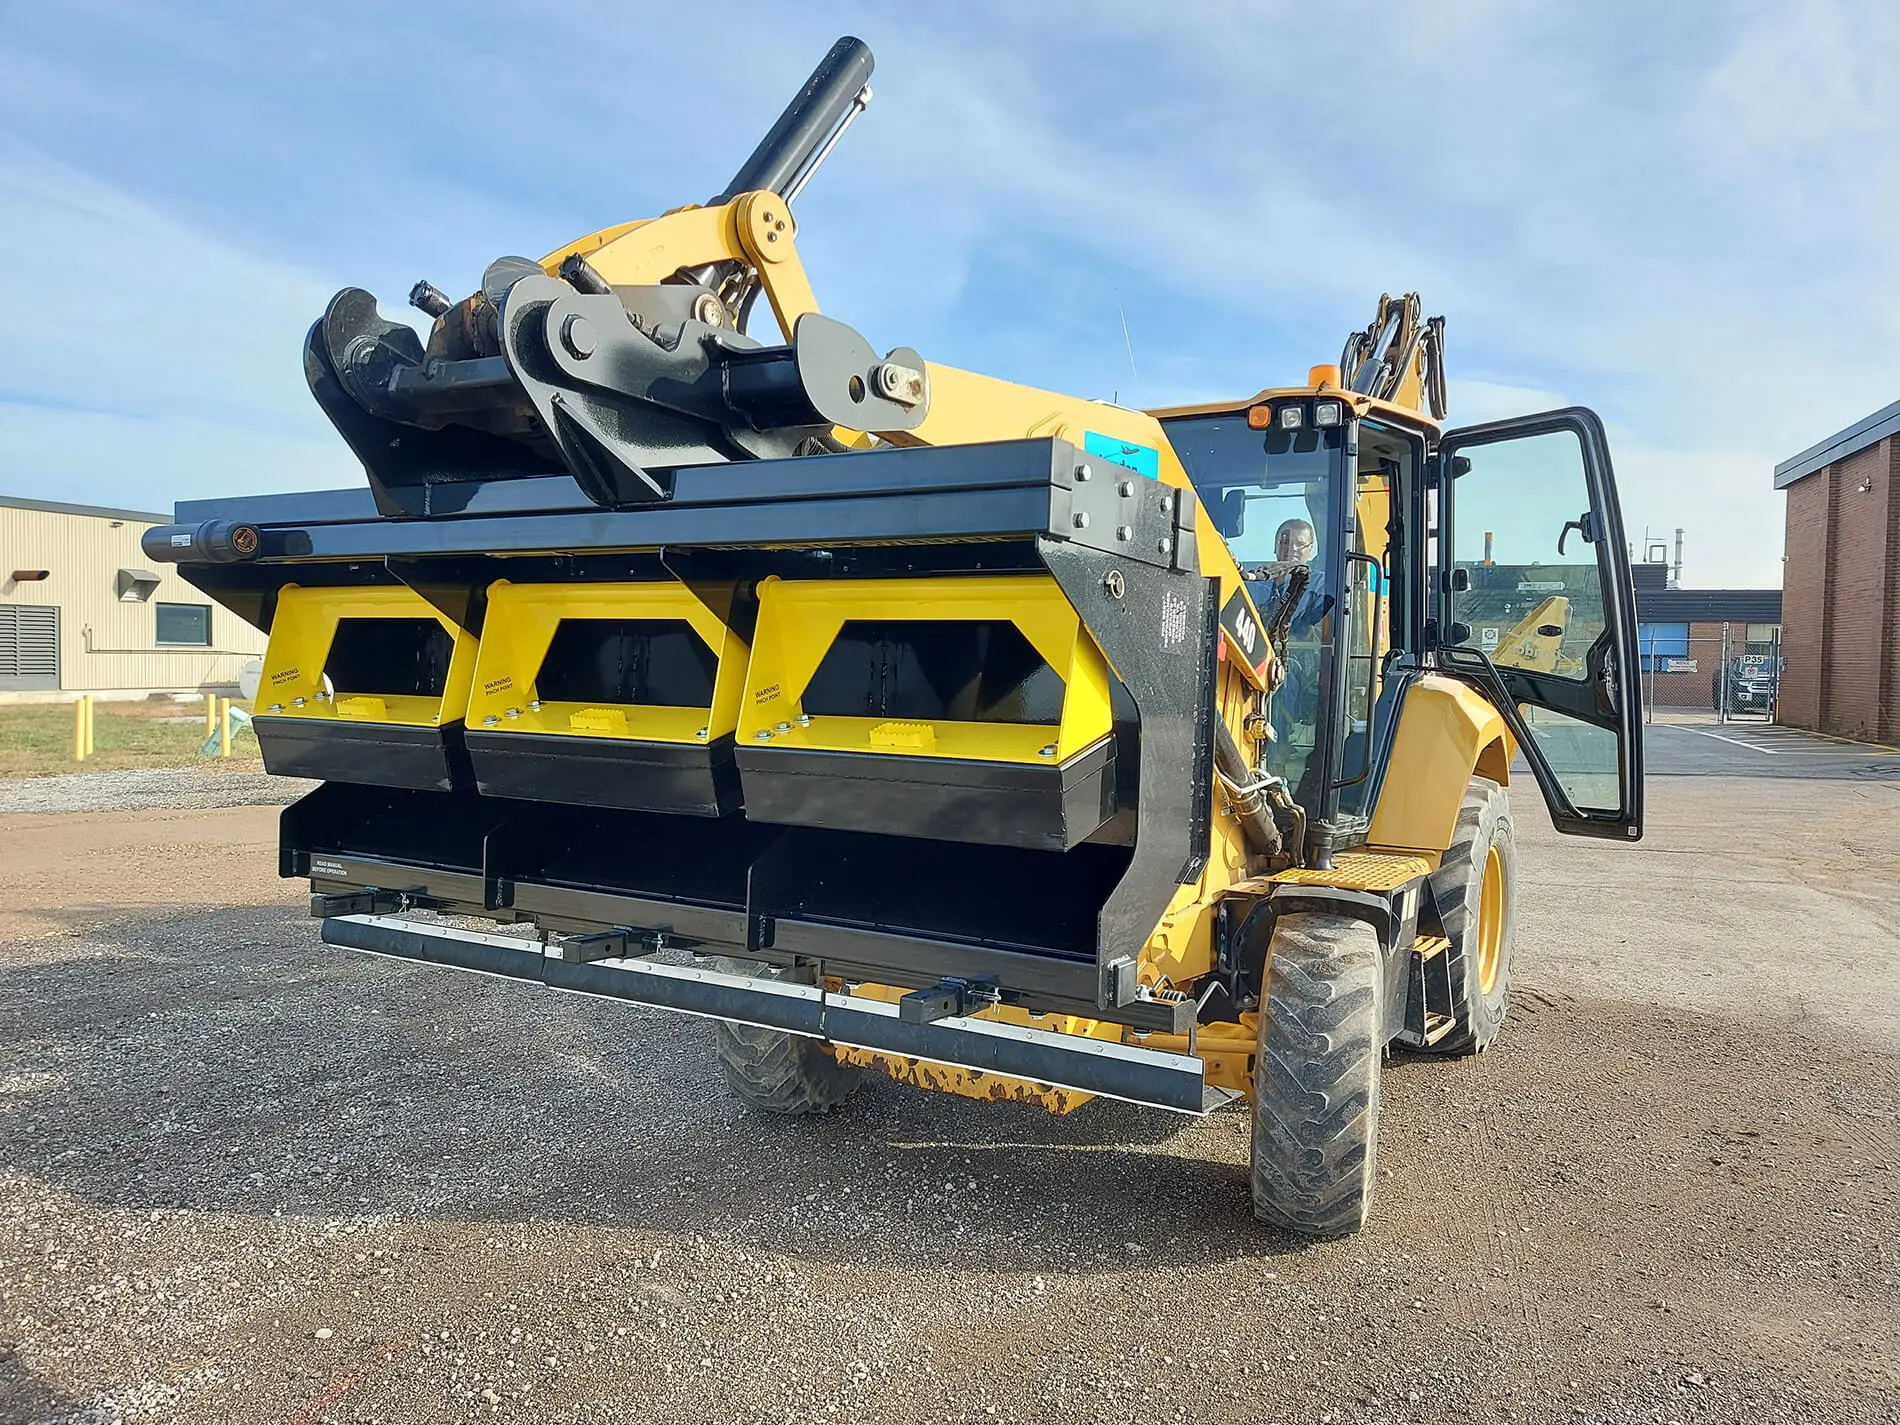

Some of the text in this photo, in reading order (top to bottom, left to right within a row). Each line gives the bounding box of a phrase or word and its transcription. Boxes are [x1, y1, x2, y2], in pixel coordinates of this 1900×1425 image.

[1235, 607, 1256, 654] 440
[271, 668, 299, 680] WARNING
[287, 673, 300, 682] POINT
[484, 676, 512, 690] WARNING
[485, 683, 513, 696] PINCH POINT
[755, 684, 780, 698] WARNING
[756, 692, 780, 705] PINCH POINT
[327, 868, 348, 876] OPERATION
